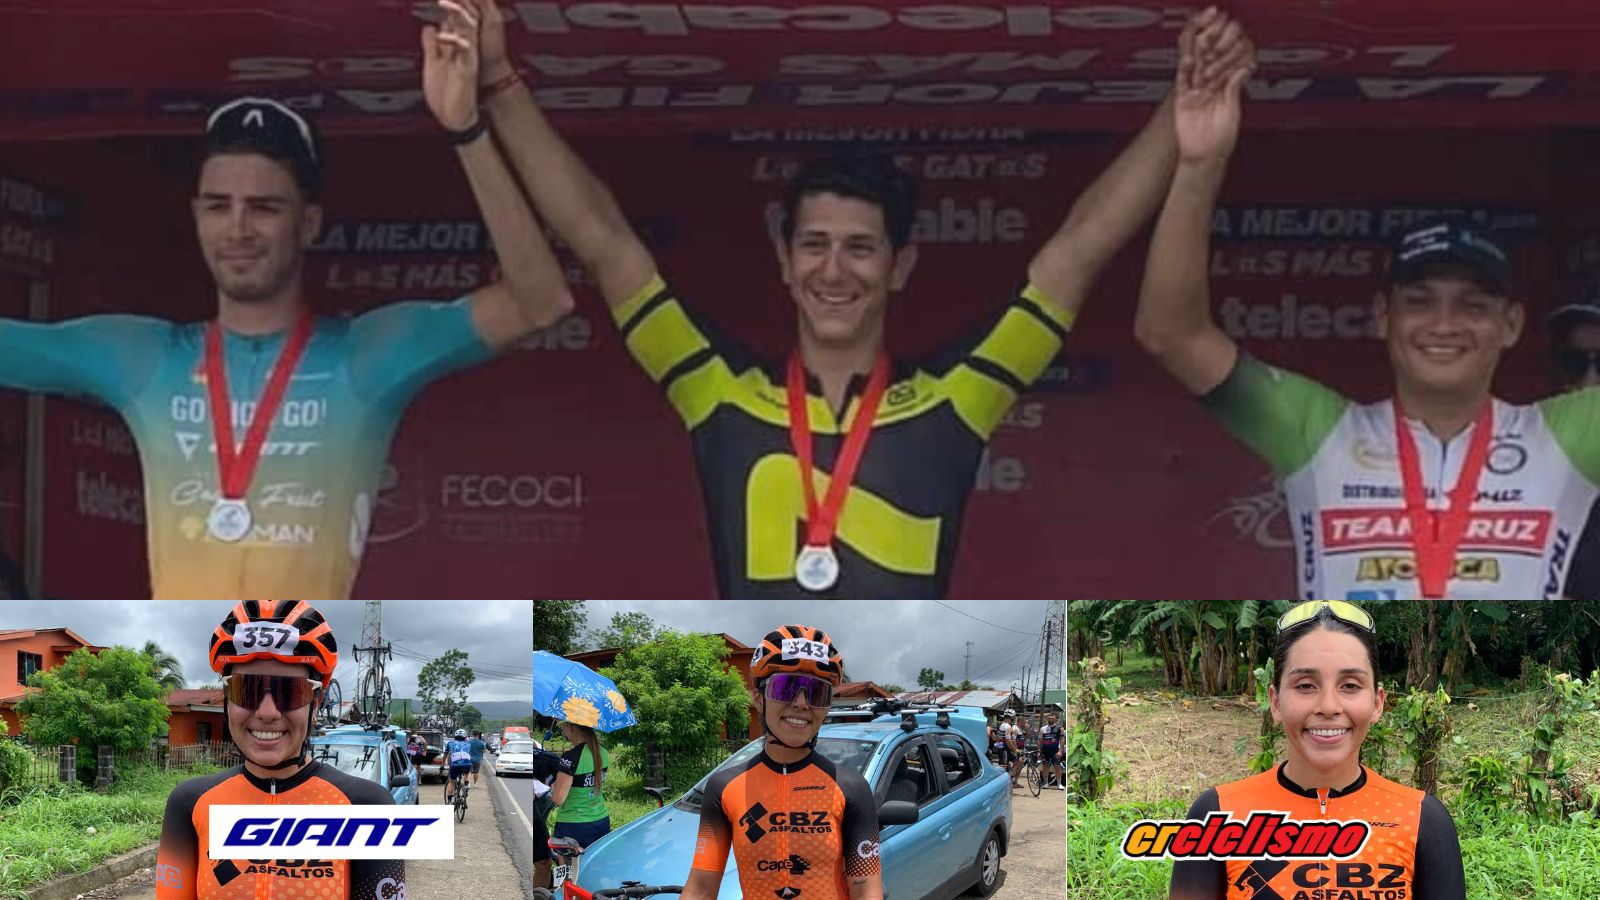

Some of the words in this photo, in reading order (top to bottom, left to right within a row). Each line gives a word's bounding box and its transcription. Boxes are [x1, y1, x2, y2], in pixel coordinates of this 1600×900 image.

[1239, 208, 1372, 236] MEJOR
[356, 221, 480, 251] MEJOR
[171, 394, 207, 424] GO
[283, 397, 328, 428] GO!
[441, 474, 584, 509] FECOCI
[242, 626, 292, 649] 357
[787, 640, 826, 659] 343
[768, 811, 831, 827] CBZ
[768, 825, 833, 834] ASFALTOS
[243, 864, 335, 879] ASFALTOS
[757, 859, 794, 876] Cape
[1291, 862, 1407, 889] CBZ
